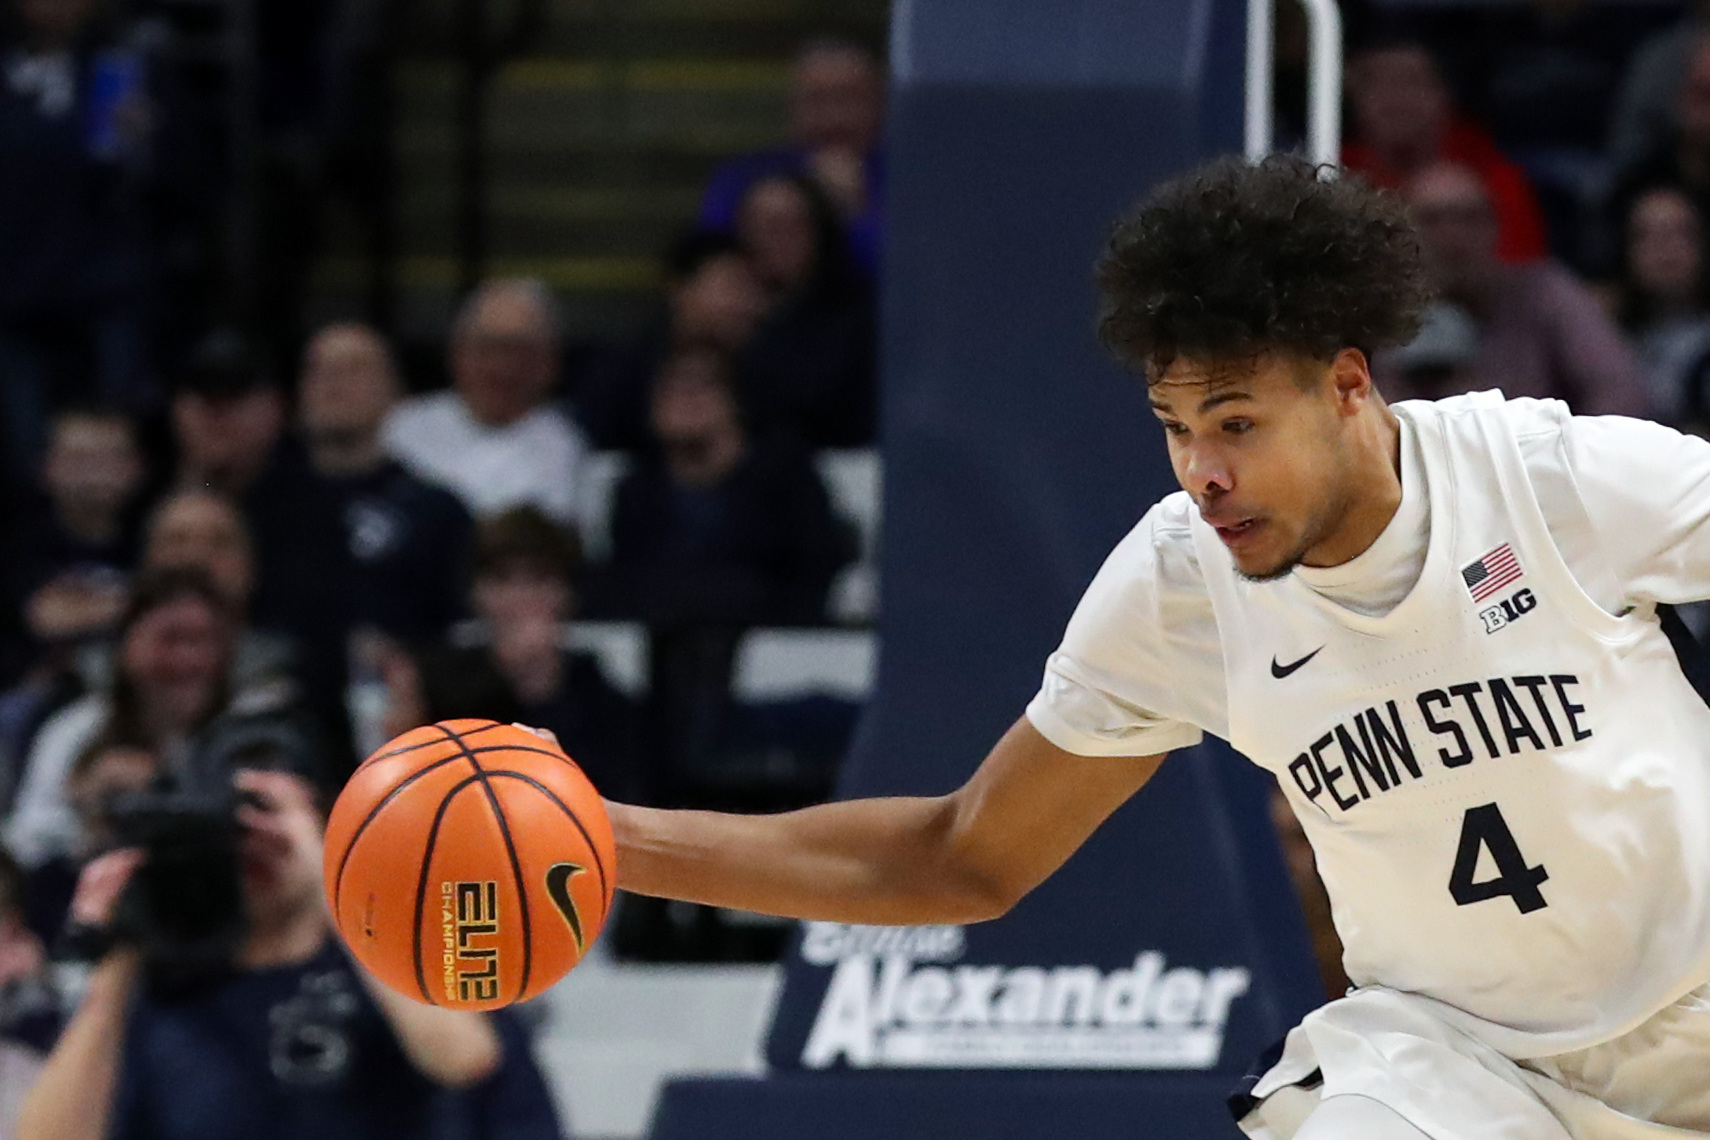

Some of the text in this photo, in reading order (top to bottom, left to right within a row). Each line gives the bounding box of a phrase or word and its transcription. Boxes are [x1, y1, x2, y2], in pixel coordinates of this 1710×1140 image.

[1287, 674, 1593, 813] PENN STATE
[1448, 801, 1550, 915] 4
[455, 880, 500, 1001] ELITE
[802, 949, 1252, 1069] Alexander
